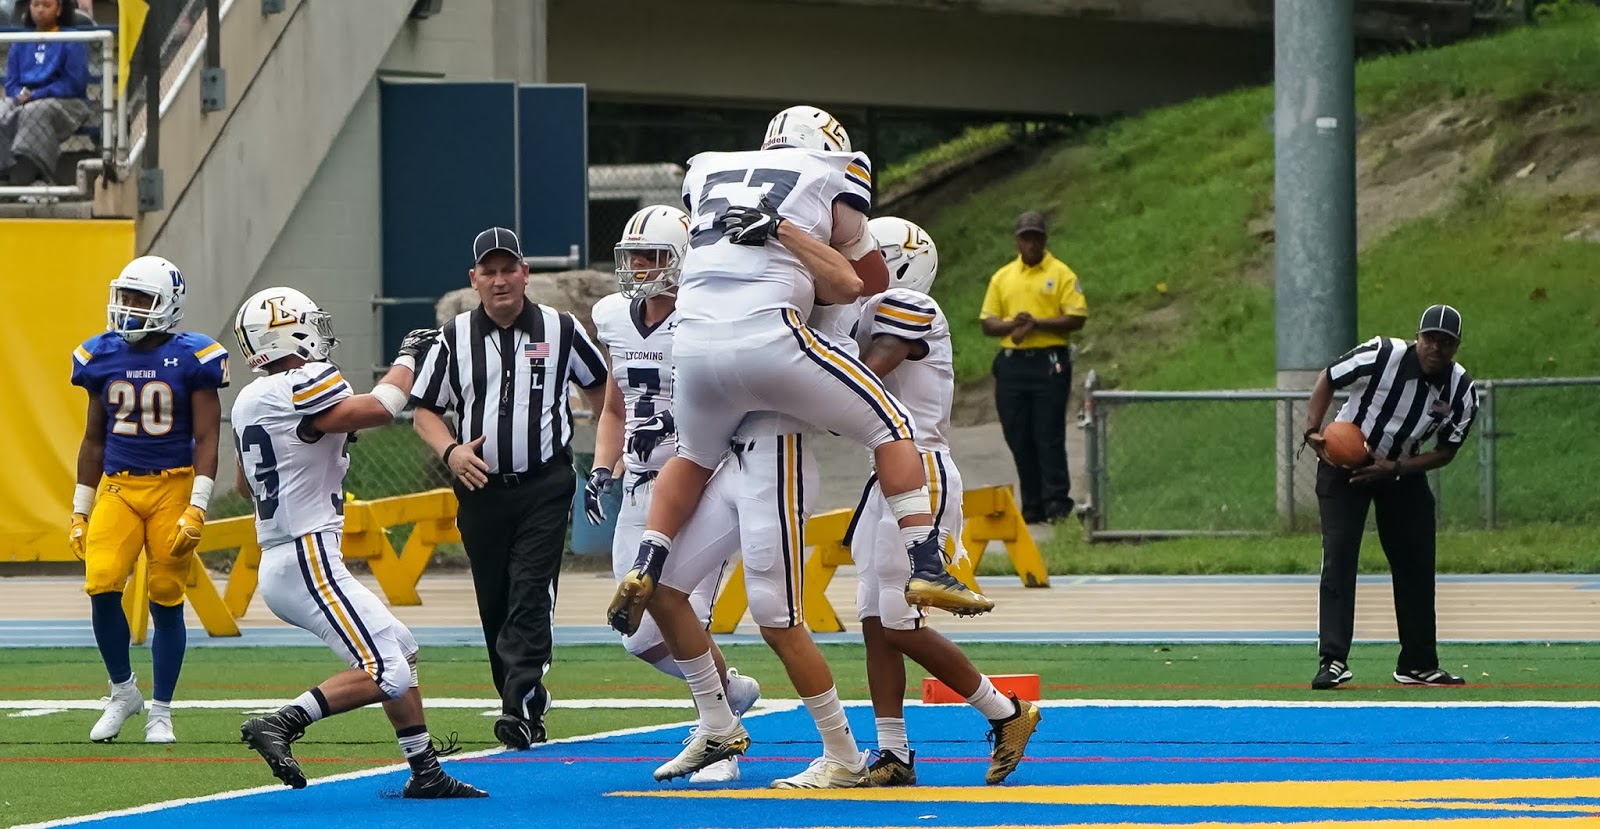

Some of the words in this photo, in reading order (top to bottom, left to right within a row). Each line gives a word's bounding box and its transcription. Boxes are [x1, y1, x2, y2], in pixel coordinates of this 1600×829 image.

[690, 168, 802, 250] 57
[266, 296, 298, 330] L
[625, 351, 663, 361] LYCOMING
[126, 369, 156, 379] WIDENER
[531, 373, 543, 390] L
[108, 380, 174, 436] 20
[627, 367, 661, 418] 7
